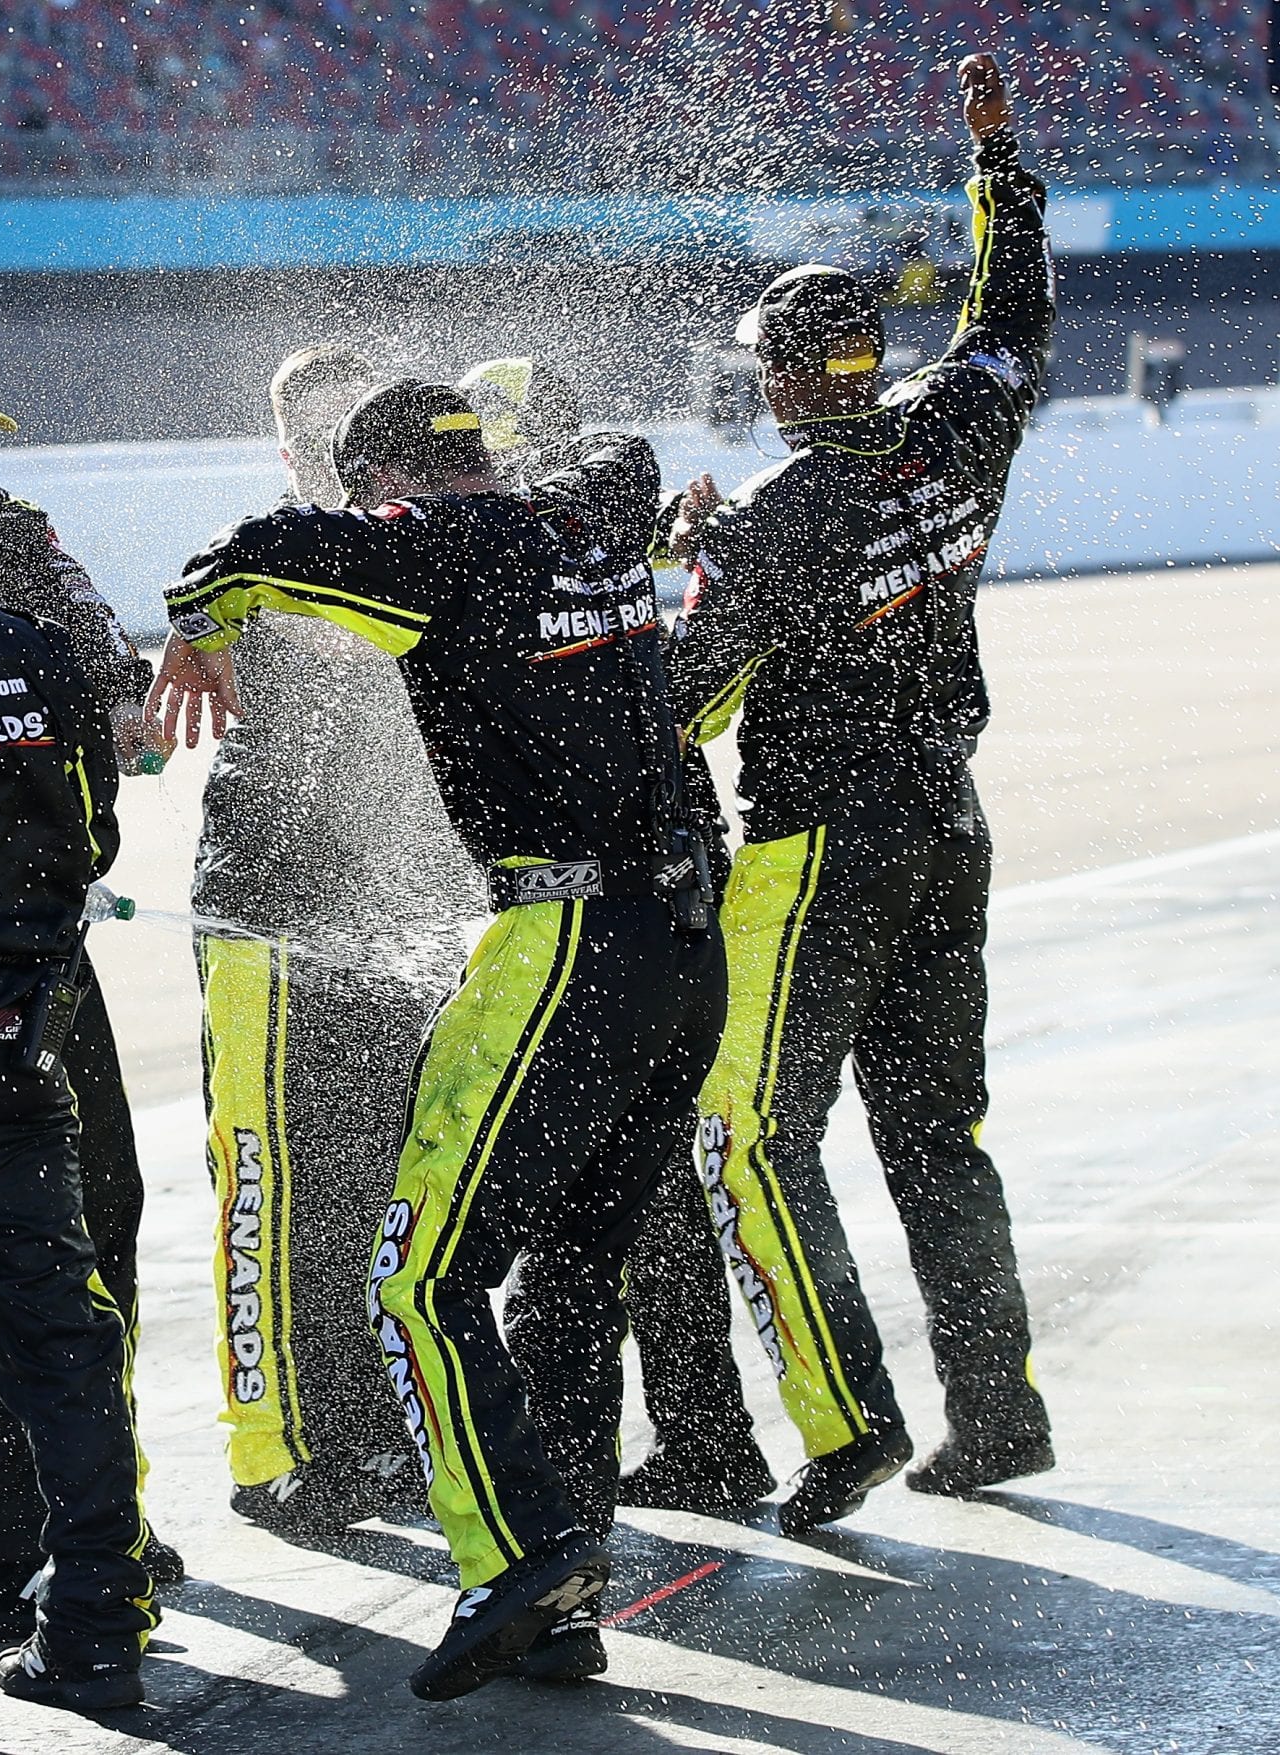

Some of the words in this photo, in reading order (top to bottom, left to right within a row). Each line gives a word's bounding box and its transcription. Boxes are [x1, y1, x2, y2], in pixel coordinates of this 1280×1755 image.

[571, 882, 601, 895] WEAR
[36, 1050, 56, 1072] 19
[230, 1127, 266, 1403] MENARDS
